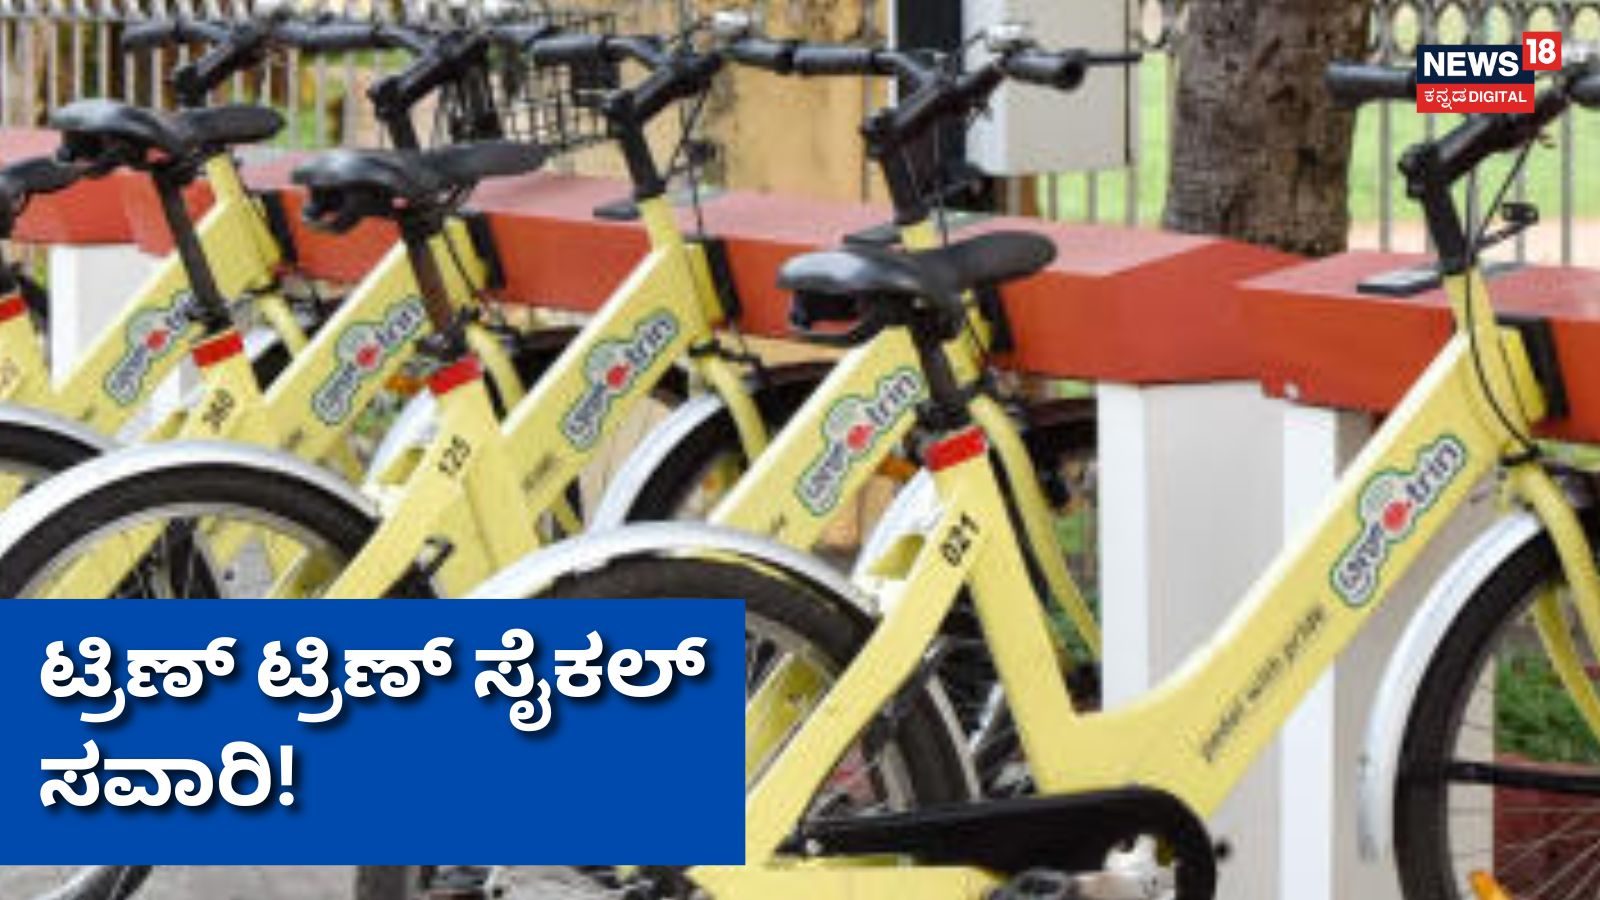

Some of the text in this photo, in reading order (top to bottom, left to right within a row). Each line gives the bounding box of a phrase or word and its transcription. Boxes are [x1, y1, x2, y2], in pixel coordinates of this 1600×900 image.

[626, 316, 674, 365] trin
[865, 371, 919, 426] trin
[438, 434, 471, 476] 125
[1405, 443, 1460, 502] trin
[941, 510, 980, 567] 021
